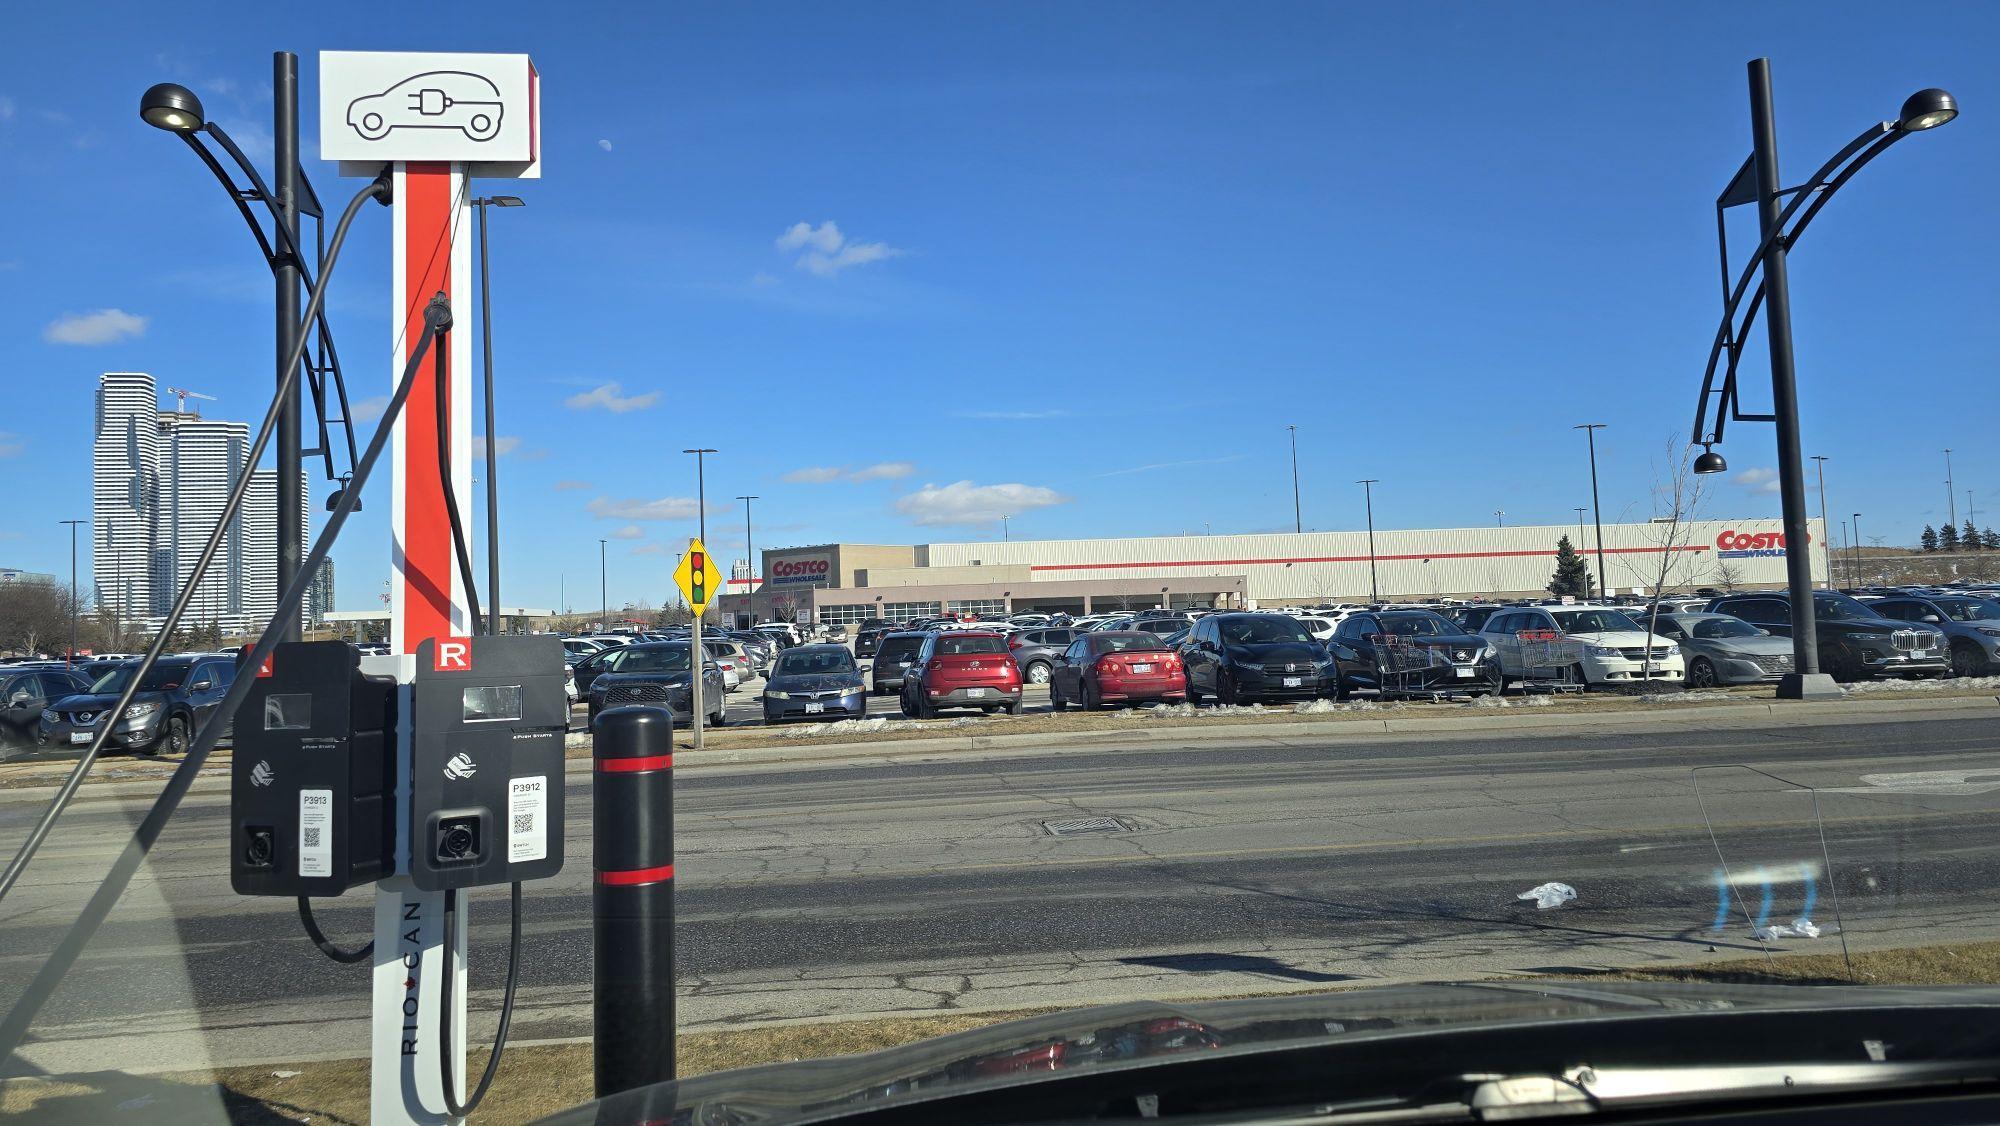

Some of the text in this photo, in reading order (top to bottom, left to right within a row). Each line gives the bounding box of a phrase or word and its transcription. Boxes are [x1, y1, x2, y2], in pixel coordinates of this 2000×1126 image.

[1716, 530, 1811, 550] COST
[772, 560, 829, 577] COSTCO
[789, 574, 826, 583] WHOLESALE
[440, 643, 467, 667] R
[513, 783, 541, 793] P3912
[304, 796, 327, 805] P3913
